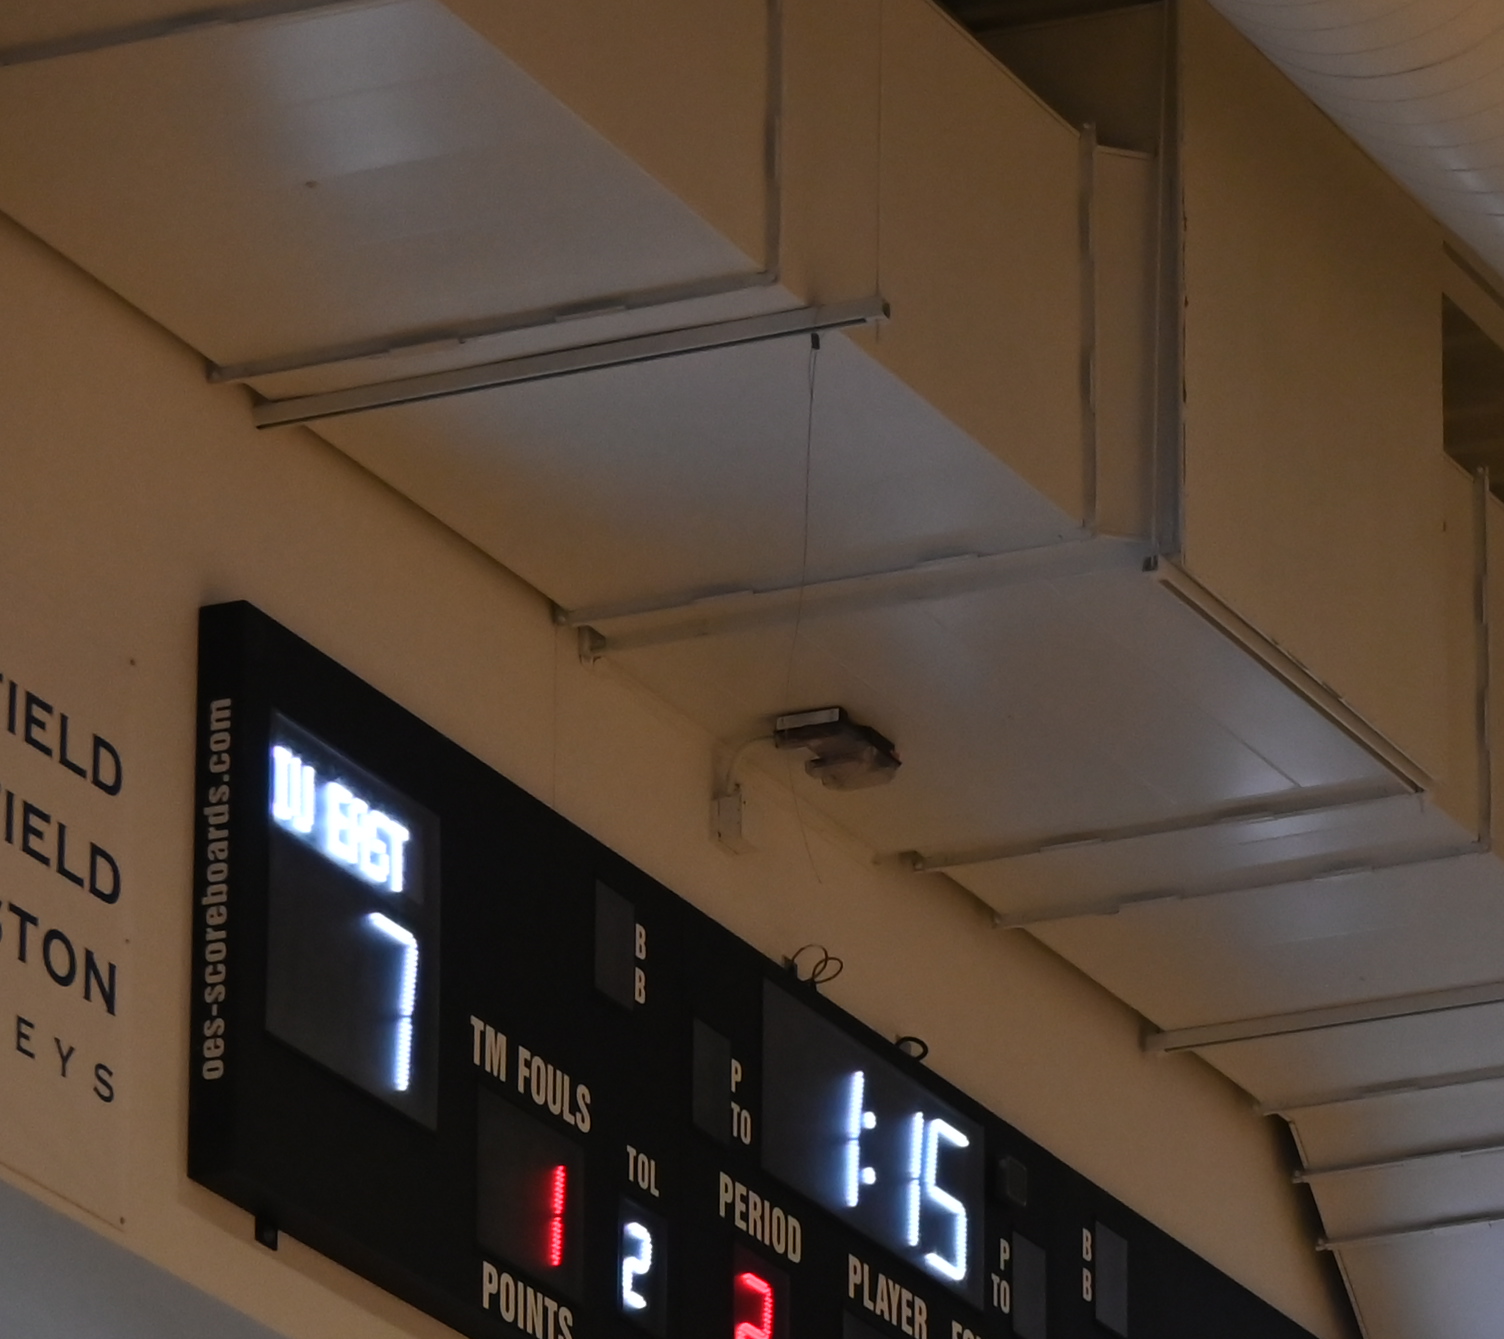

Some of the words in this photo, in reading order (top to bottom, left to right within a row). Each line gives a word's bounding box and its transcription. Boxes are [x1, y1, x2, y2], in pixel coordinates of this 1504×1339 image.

[0, 673, 123, 797] IELD
[0, 783, 121, 905] IELD
[202, 698, 231, 1081] oes-scoreboards.com
[0, 902, 117, 1017] TON
[634, 923, 647, 960] B
[634, 967, 647, 1005] B
[366, 910, 420, 1092] 7
[470, 1014, 507, 1084] TM
[517, 1045, 592, 1135] FOULS
[730, 1057, 742, 1093] P
[730, 1100, 752, 1146] TO
[549, 1165, 567, 1267] 1
[626, 1145, 660, 1198] TOL
[846, 1070, 969, 1282] 1:15
[718, 1171, 803, 1265] PERIOD
[998, 1238, 1011, 1272] P
[1081, 1227, 1093, 1262] B
[622, 1221, 653, 1311] 2
[991, 1273, 1012, 1314] TO
[1081, 1266, 1093, 1303] B
